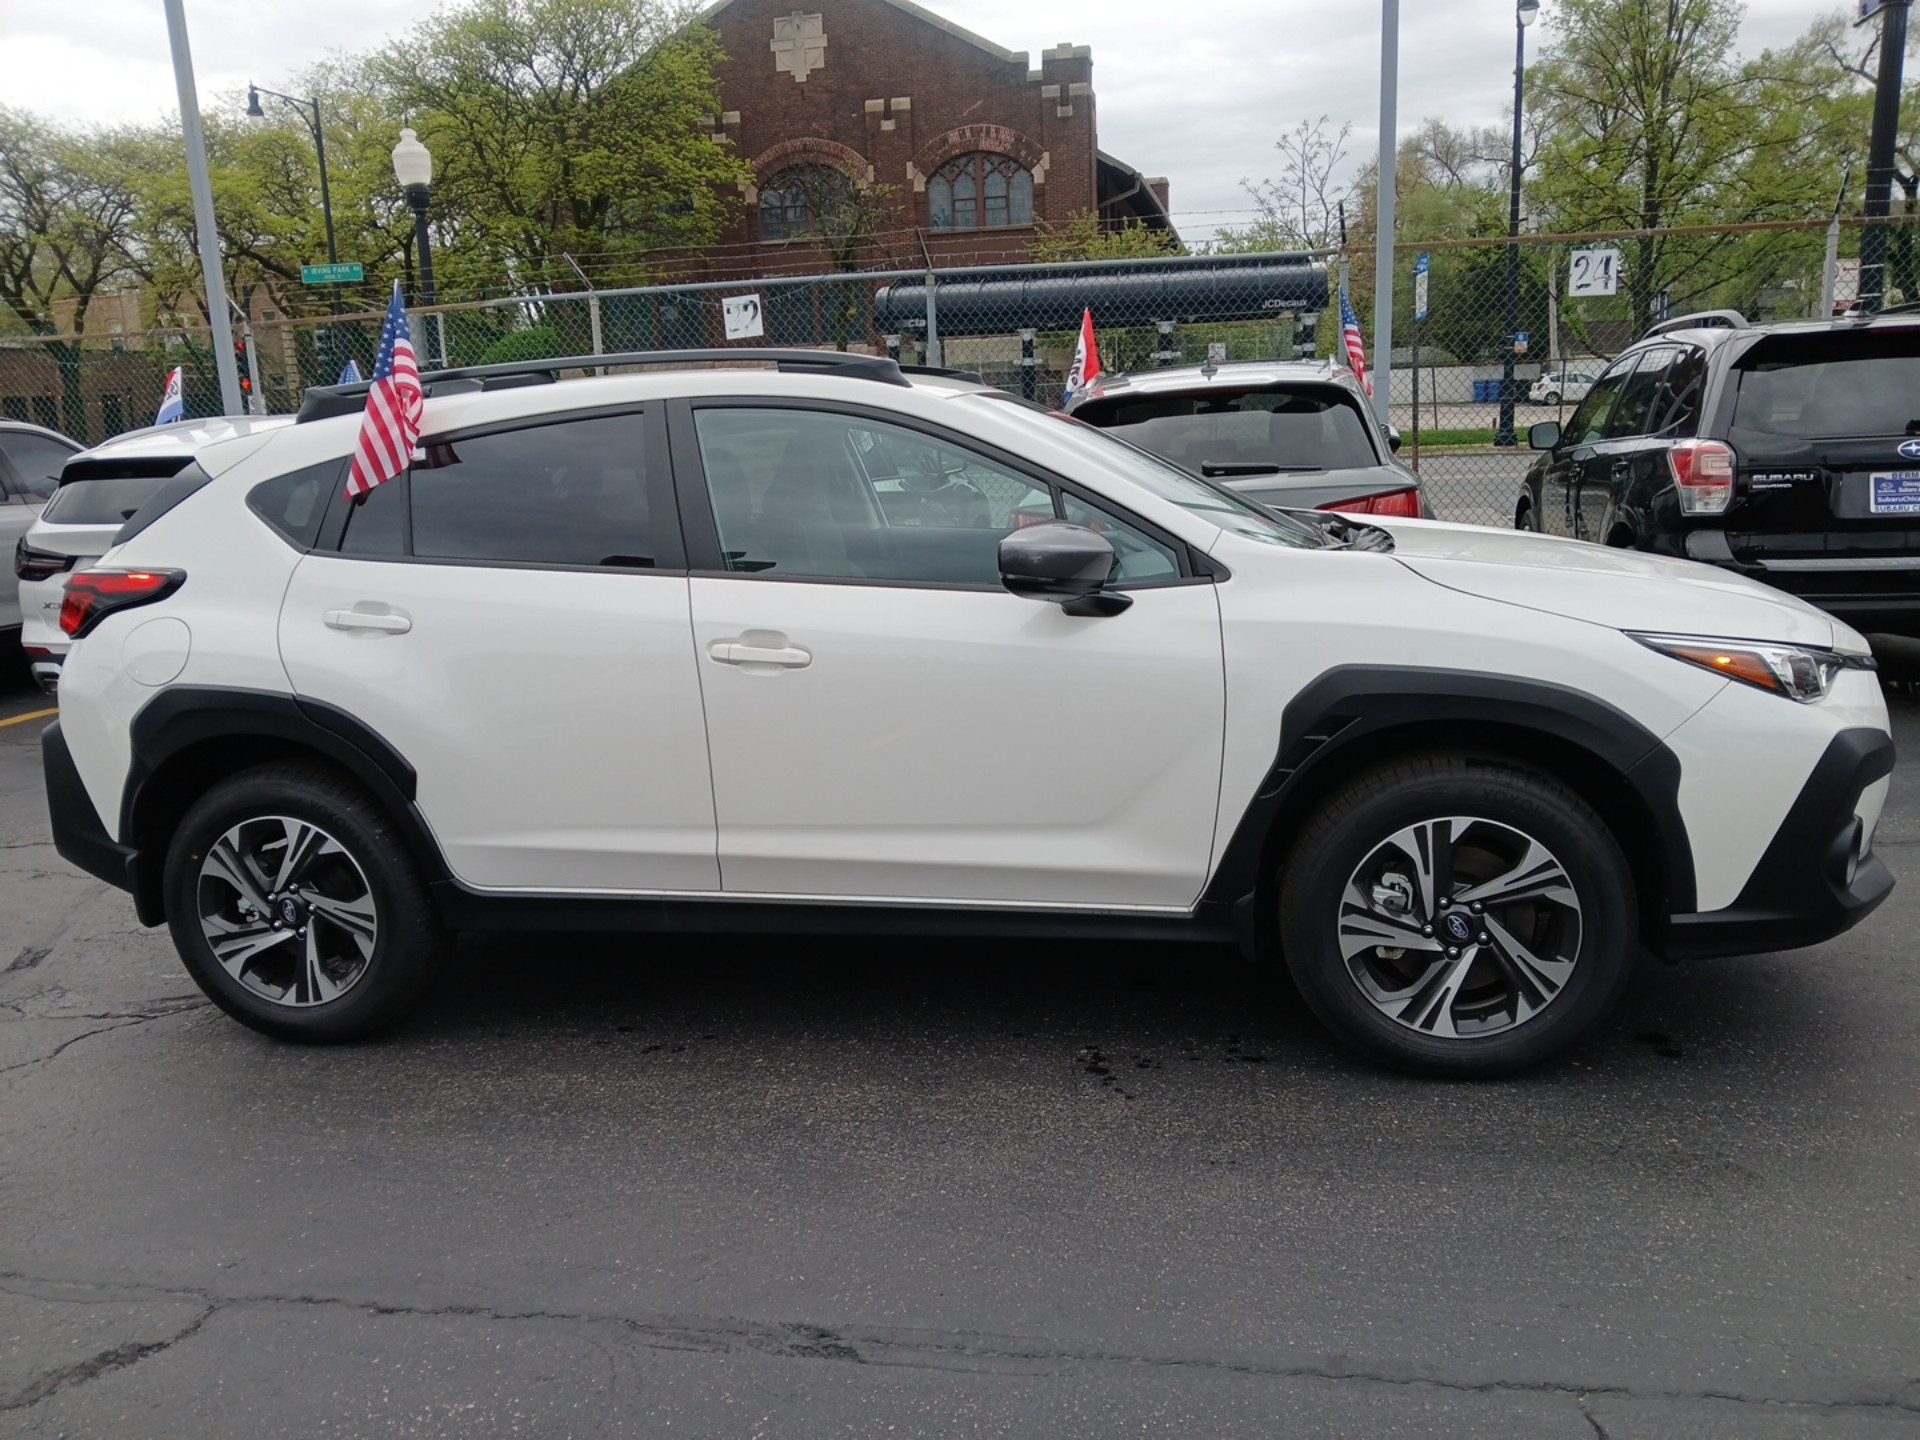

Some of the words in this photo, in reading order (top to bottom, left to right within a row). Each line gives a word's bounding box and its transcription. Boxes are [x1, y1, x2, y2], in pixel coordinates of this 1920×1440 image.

[1574, 255, 1612, 290] 24
[1262, 299, 1308, 309] JCDecaux
[1753, 473, 1814, 481] SUBARU
[1875, 504, 1909, 512] SUBARU
